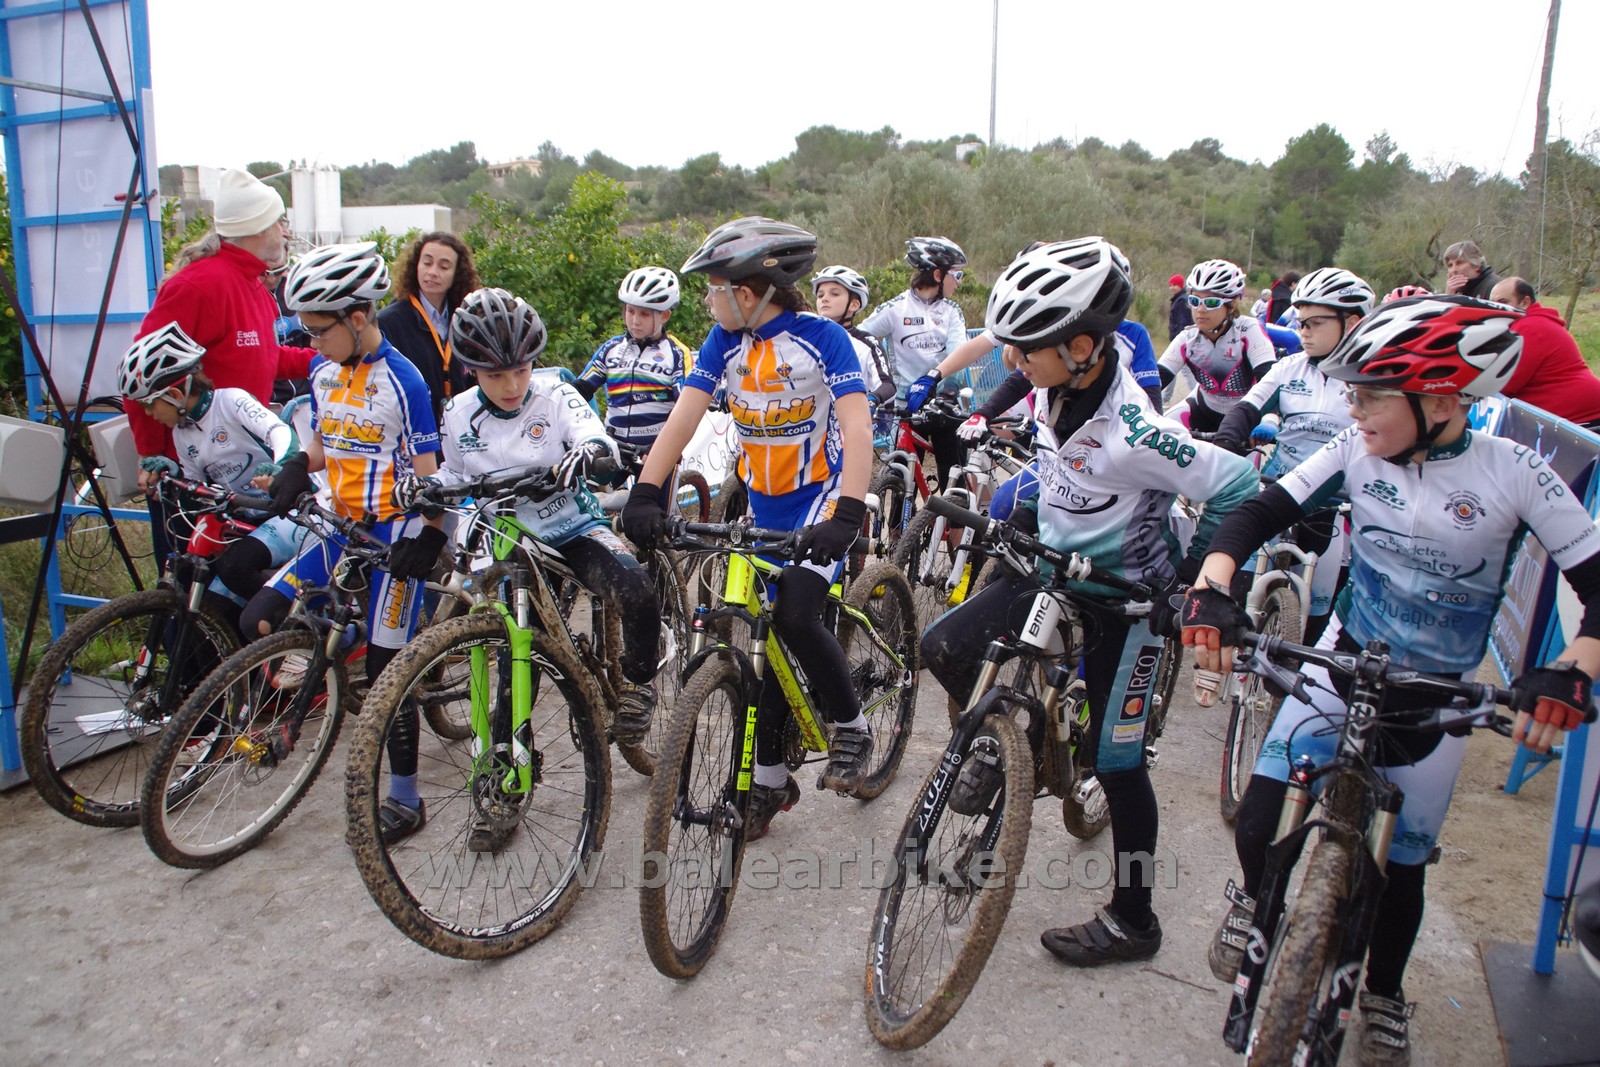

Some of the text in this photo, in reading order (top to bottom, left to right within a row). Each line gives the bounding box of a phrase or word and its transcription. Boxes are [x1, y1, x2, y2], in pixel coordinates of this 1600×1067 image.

[607, 356, 674, 376] Sancho
[728, 392, 816, 428] binbit
[1118, 402, 1197, 469] aquae
[1028, 595, 1051, 637] BMC
[1130, 654, 1157, 690] RCO
[741, 705, 757, 769] REBA
